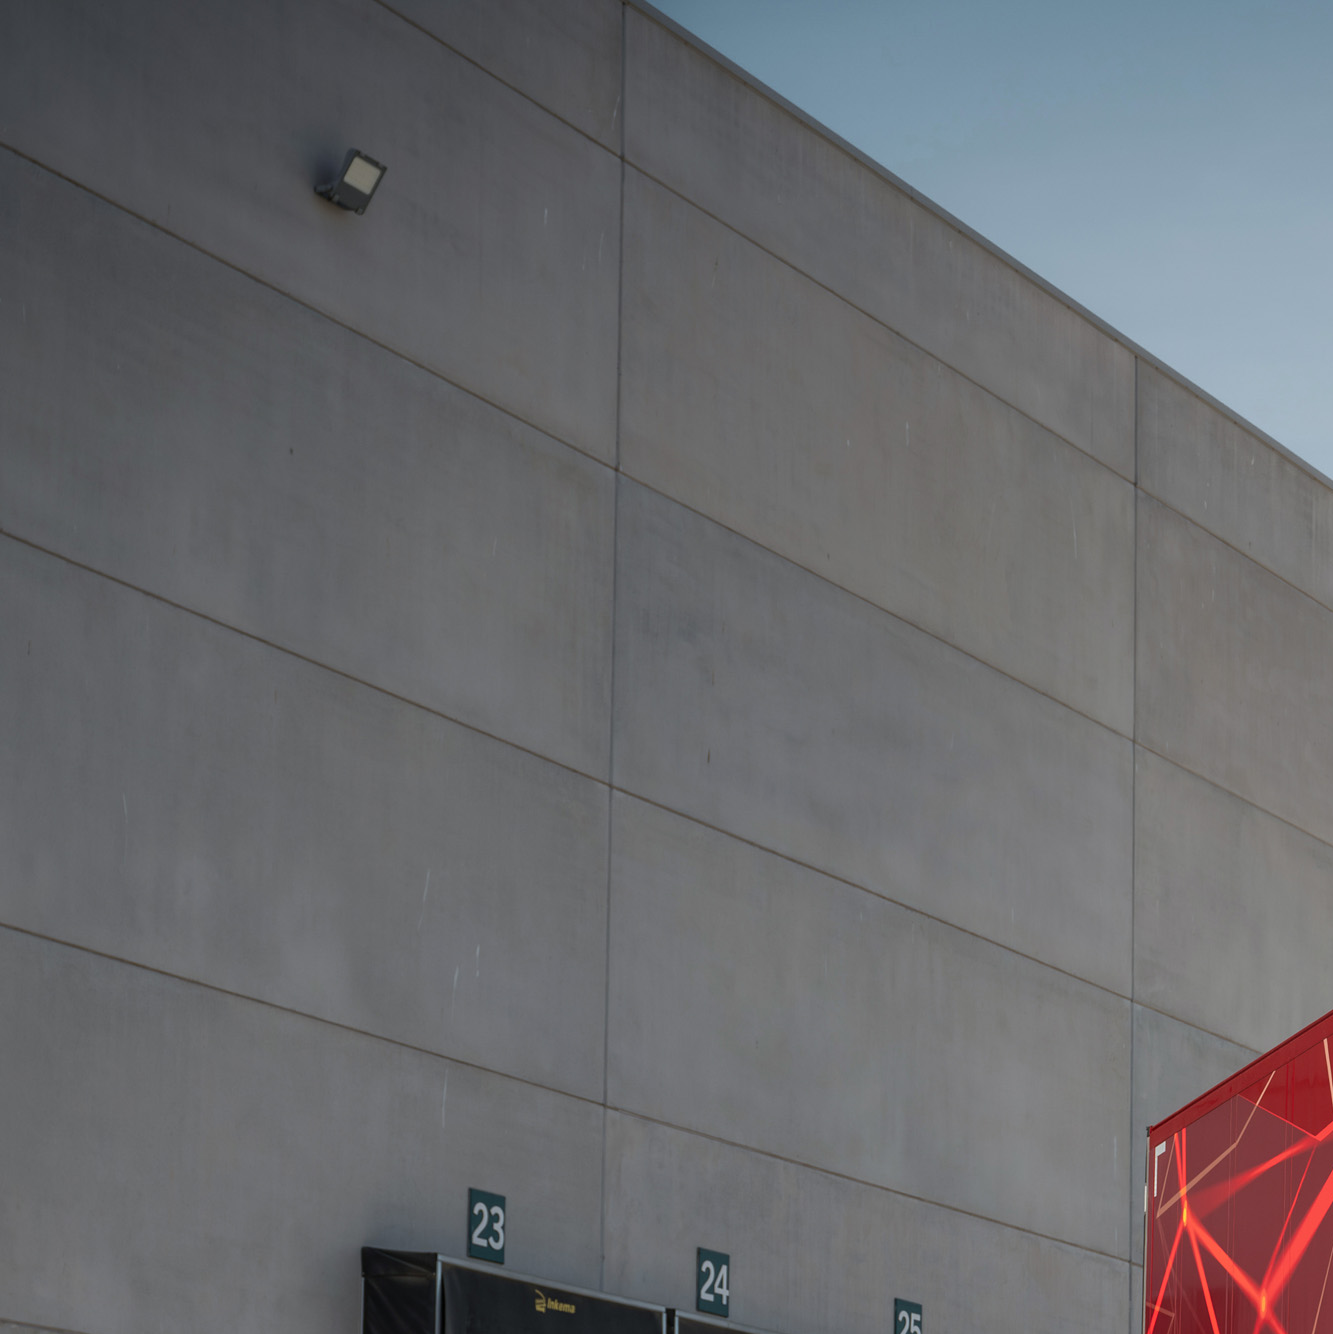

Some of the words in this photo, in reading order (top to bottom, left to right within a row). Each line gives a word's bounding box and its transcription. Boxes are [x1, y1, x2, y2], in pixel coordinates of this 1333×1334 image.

[472, 1202, 505, 1250] 23
[700, 1260, 729, 1305] 24
[547, 1298, 575, 1314] Inkema
